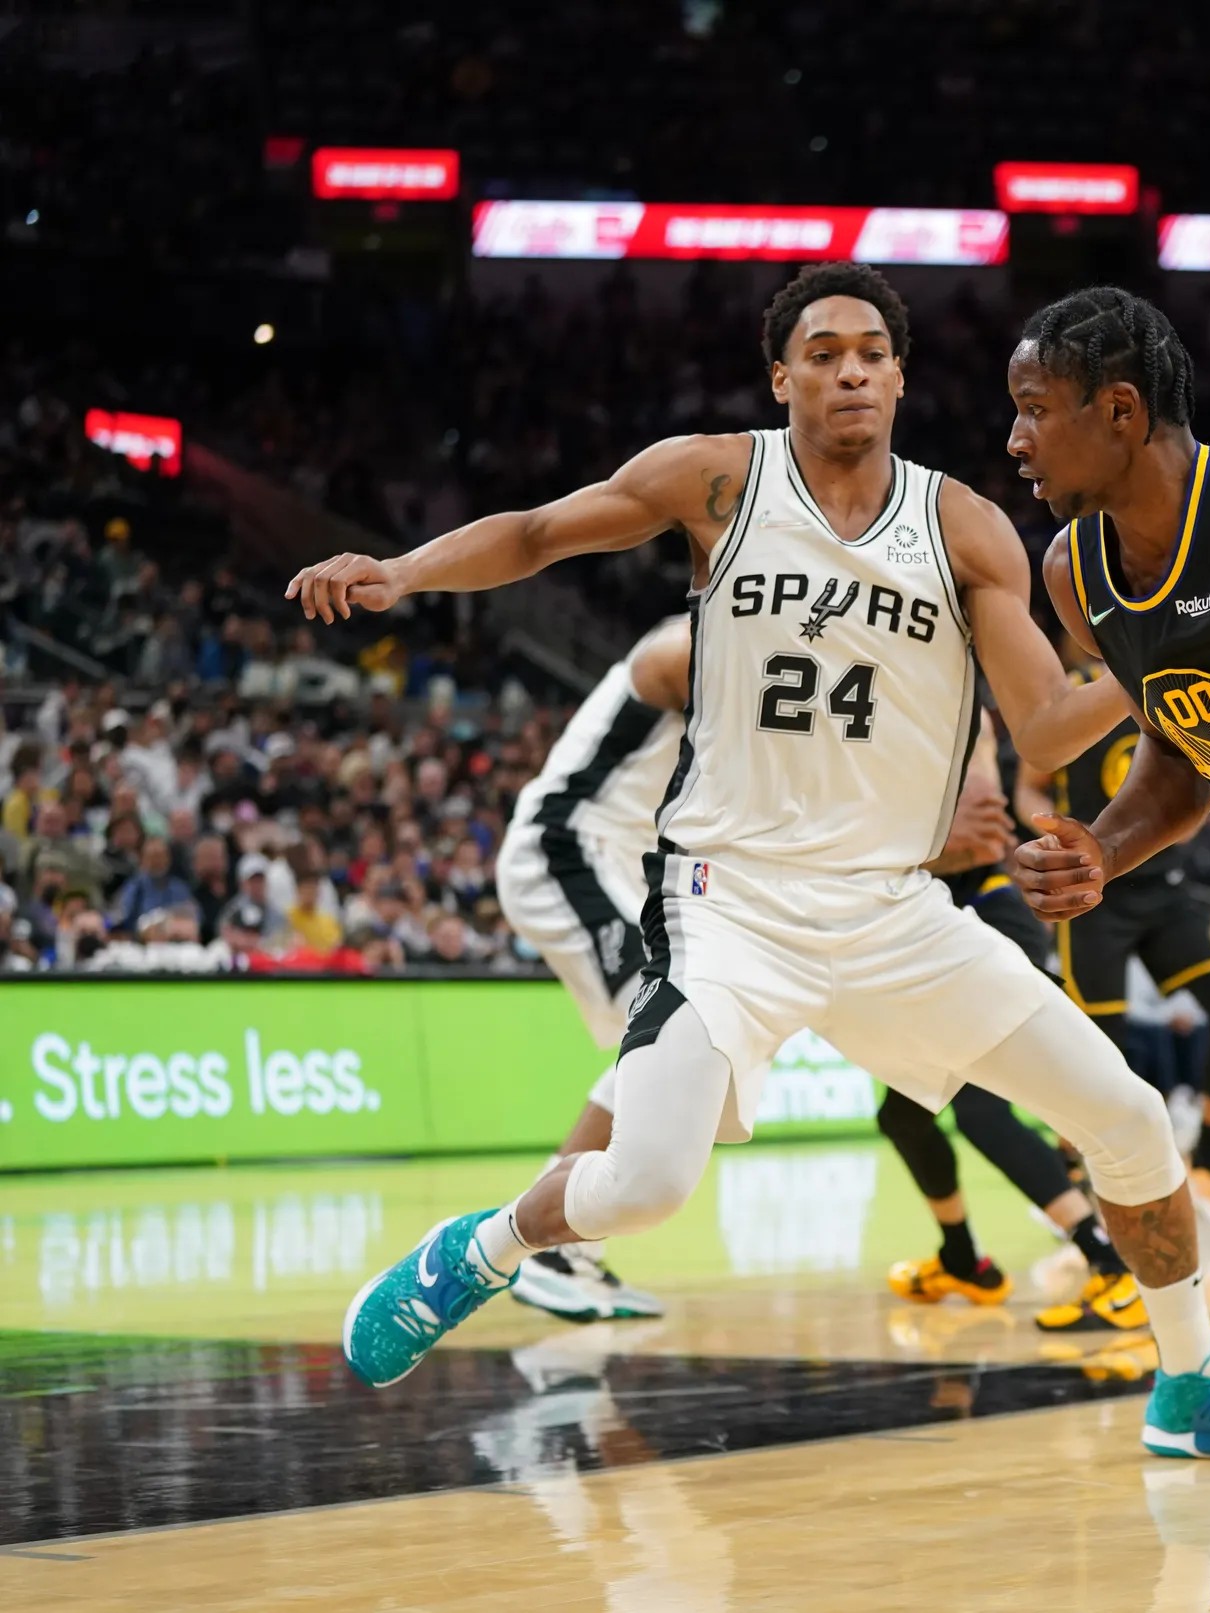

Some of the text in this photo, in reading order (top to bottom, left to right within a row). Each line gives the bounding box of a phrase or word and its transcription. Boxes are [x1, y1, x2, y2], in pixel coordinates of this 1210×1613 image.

[886, 545, 930, 565] Frost
[731, 573, 940, 644] SPURS
[756, 650, 880, 743] 24
[31, 1026, 382, 1123] Stress less.
